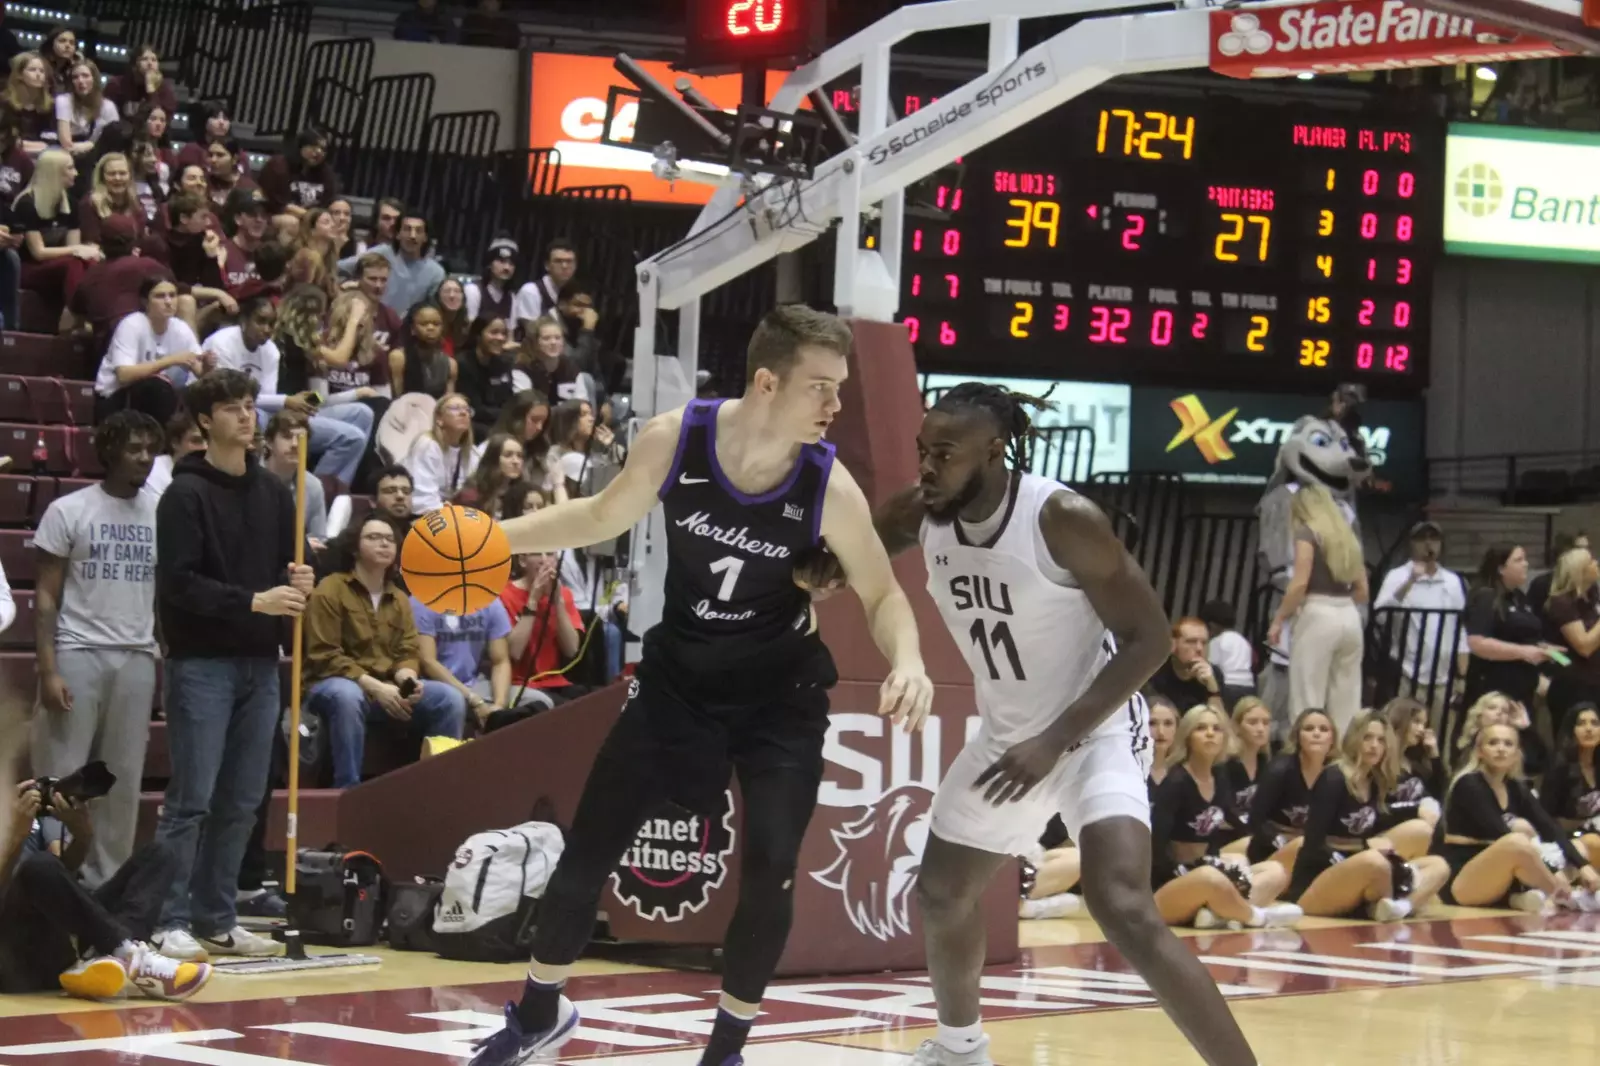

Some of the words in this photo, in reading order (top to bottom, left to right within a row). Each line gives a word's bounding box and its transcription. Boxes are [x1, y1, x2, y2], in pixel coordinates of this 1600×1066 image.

[888, 101, 973, 155] Schelde
[975, 60, 1047, 107] Sports
[1097, 109, 1195, 160] 17:24
[1363, 169, 1379, 196] 0
[1398, 172, 1414, 198] 0
[1004, 199, 1060, 247] 39
[1511, 187, 1600, 225] Bant
[943, 229, 960, 256] 0
[1122, 214, 1144, 250] 2
[1214, 213, 1271, 261] 27
[1318, 209, 1334, 236] 3
[1361, 213, 1377, 238] 0
[1396, 215, 1413, 241] 8
[1316, 255, 1333, 278] 4
[1396, 258, 1412, 284] 3
[1010, 302, 1033, 338] 2
[1054, 304, 1069, 331] 3
[1088, 306, 1131, 343] 32
[1151, 310, 1173, 345] 0
[1191, 313, 1208, 338] 2
[1307, 297, 1331, 323] 15
[1358, 300, 1375, 325] 2
[1394, 301, 1410, 327] 0
[940, 321, 956, 345] 6
[1246, 316, 1269, 351] 2
[1299, 339, 1330, 367] 32
[1357, 343, 1373, 369] 0
[1385, 345, 1409, 371] 12
[100, 524, 153, 542] PAUSED
[676, 511, 790, 559] Northern
[89, 543, 110, 560] MY
[114, 544, 153, 563] GAME
[82, 562, 97, 579] TO
[102, 563, 119, 580] BE
[709, 555, 745, 602] 1
[949, 575, 1014, 616] SIU
[970, 618, 1027, 681] 11
[637, 815, 699, 843] anet
